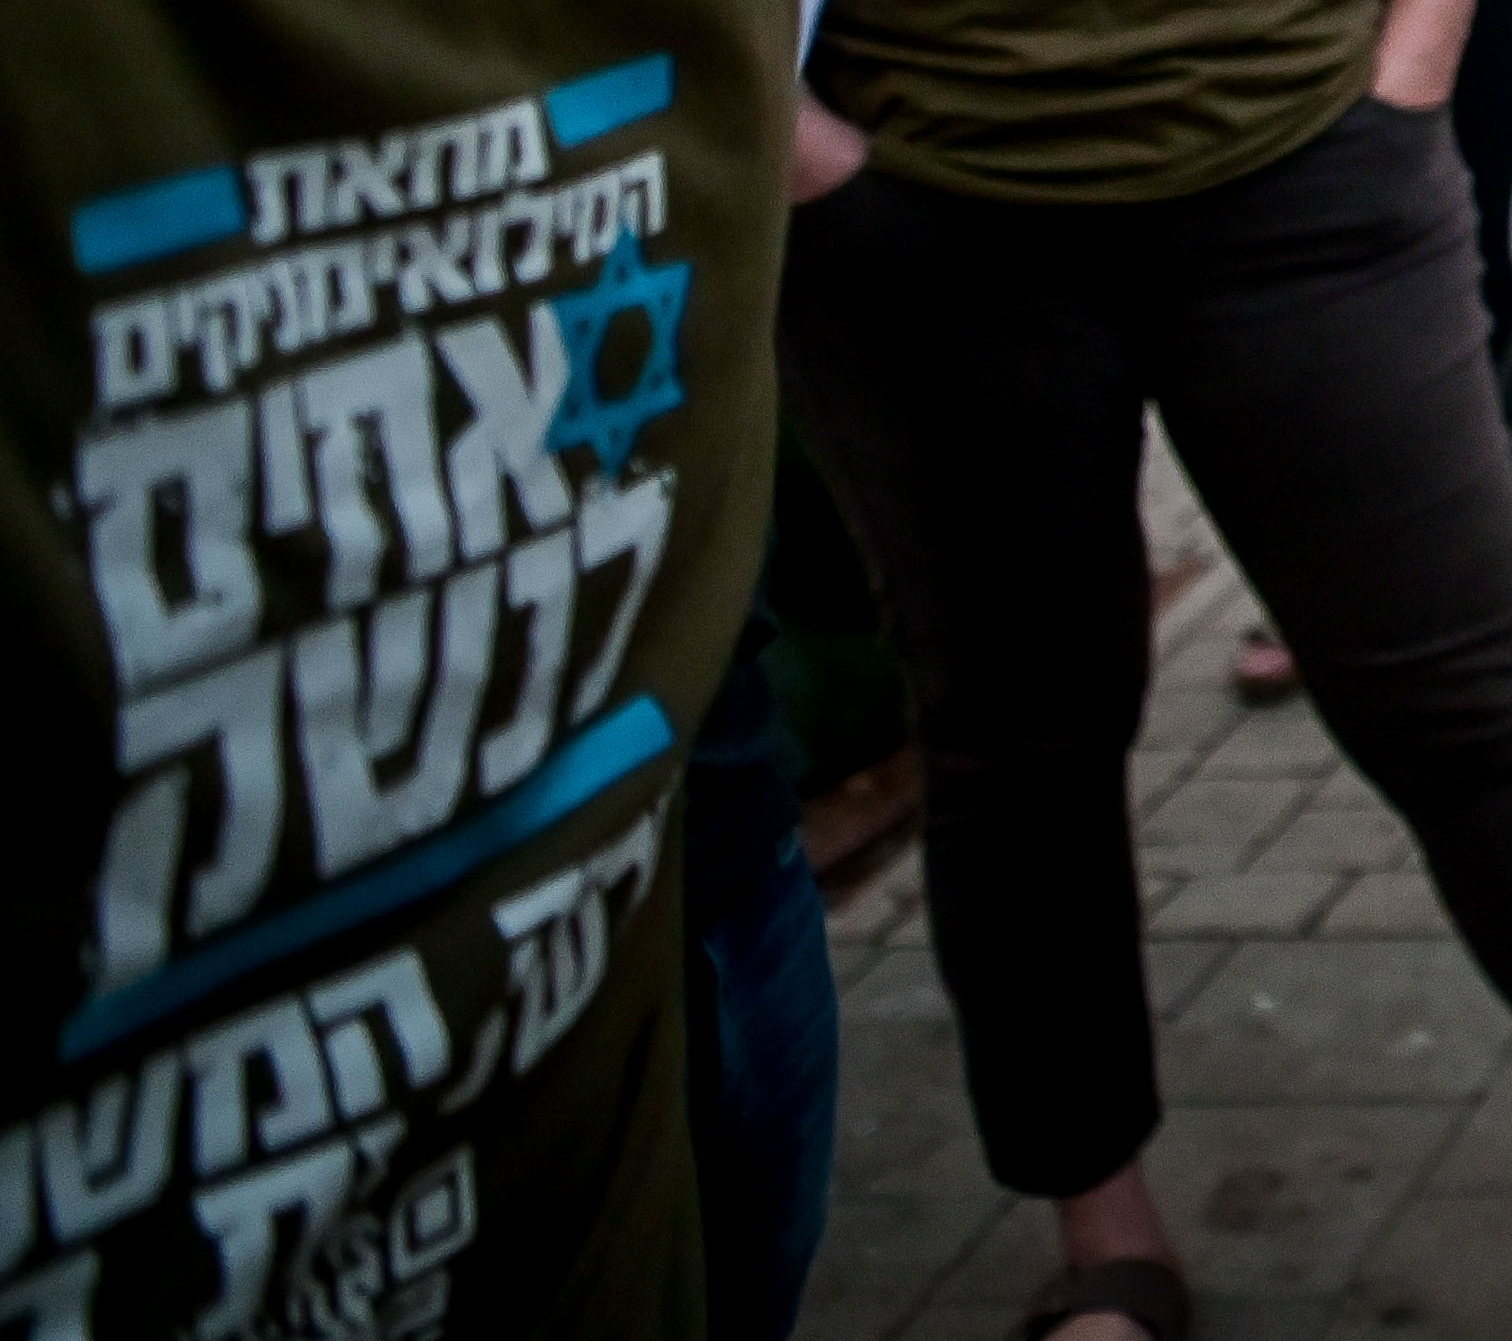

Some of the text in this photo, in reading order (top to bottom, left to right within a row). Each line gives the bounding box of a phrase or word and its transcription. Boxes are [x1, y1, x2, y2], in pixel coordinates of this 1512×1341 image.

[93, 151, 668, 407] המילואימניקים
[248, 97, 551, 245] מחאת
[77, 301, 573, 693] אחים
[92, 465, 679, 993] לנשק
[0, 943, 454, 1280] המש
